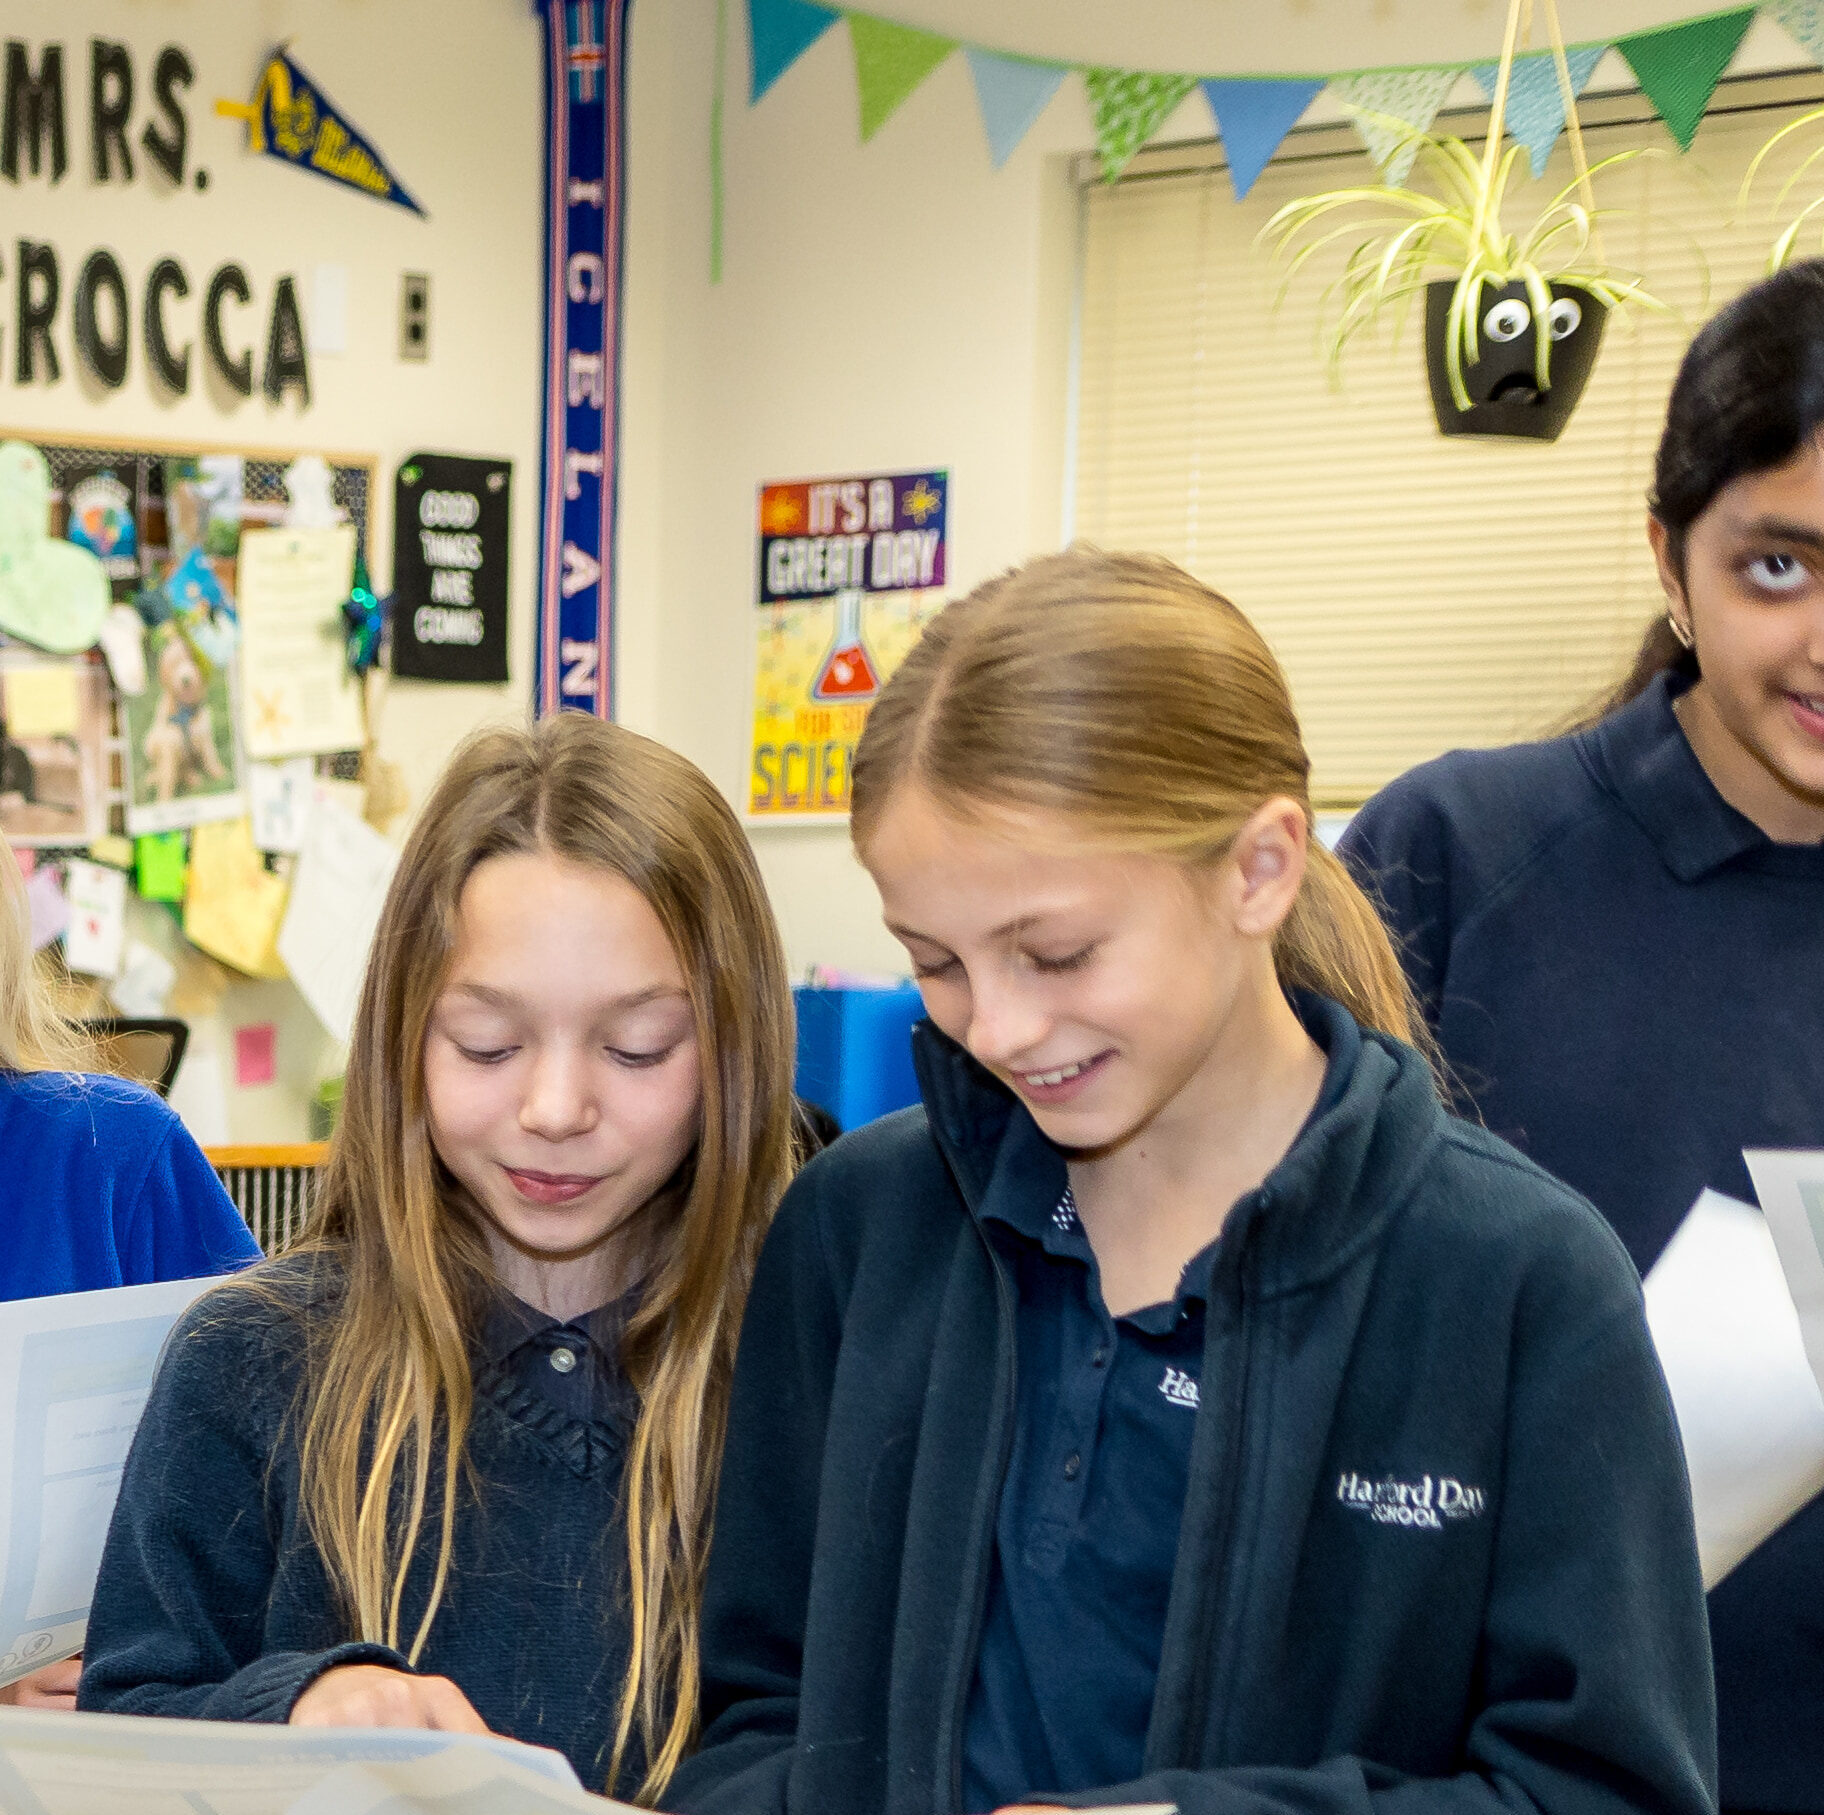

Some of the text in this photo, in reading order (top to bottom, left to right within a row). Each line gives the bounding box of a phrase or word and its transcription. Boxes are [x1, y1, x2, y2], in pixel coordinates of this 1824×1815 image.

[559, 176, 606, 700] ICELAN
[868, 479, 895, 531] A
[767, 528, 939, 596] GREAT DAY
